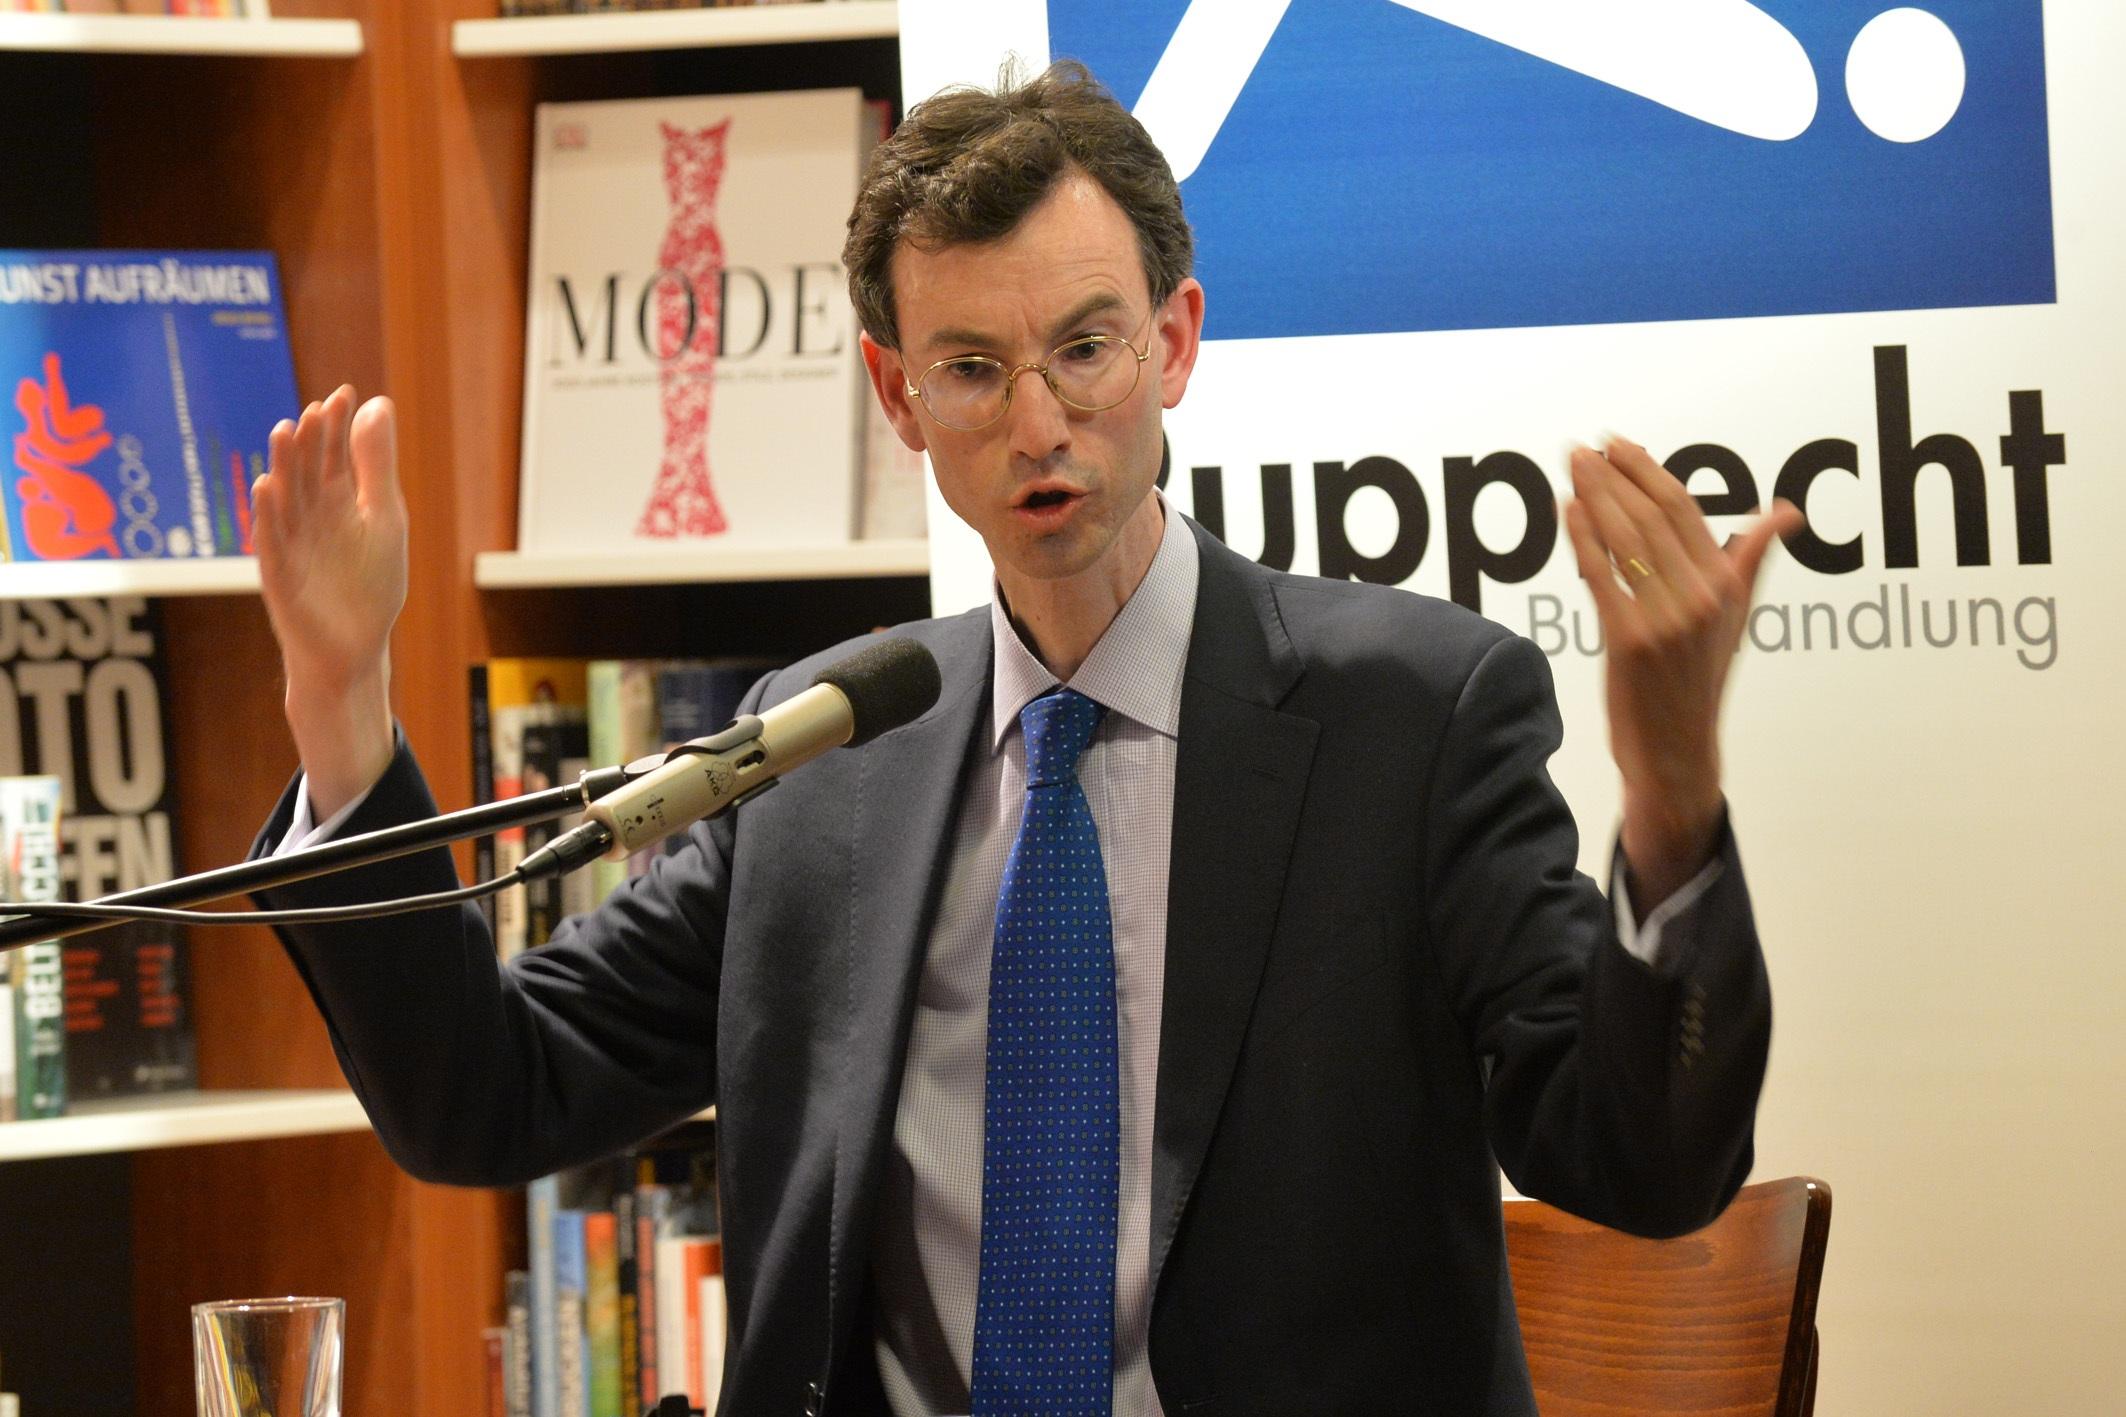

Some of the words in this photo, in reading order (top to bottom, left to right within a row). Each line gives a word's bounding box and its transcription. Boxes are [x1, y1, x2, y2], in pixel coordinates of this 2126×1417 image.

[84, 257, 271, 305] AUFRÄUMEN
[549, 261, 844, 367] MODE
[1155, 344, 2067, 615] uppecht
[1528, 583, 2059, 671] Buandlung
